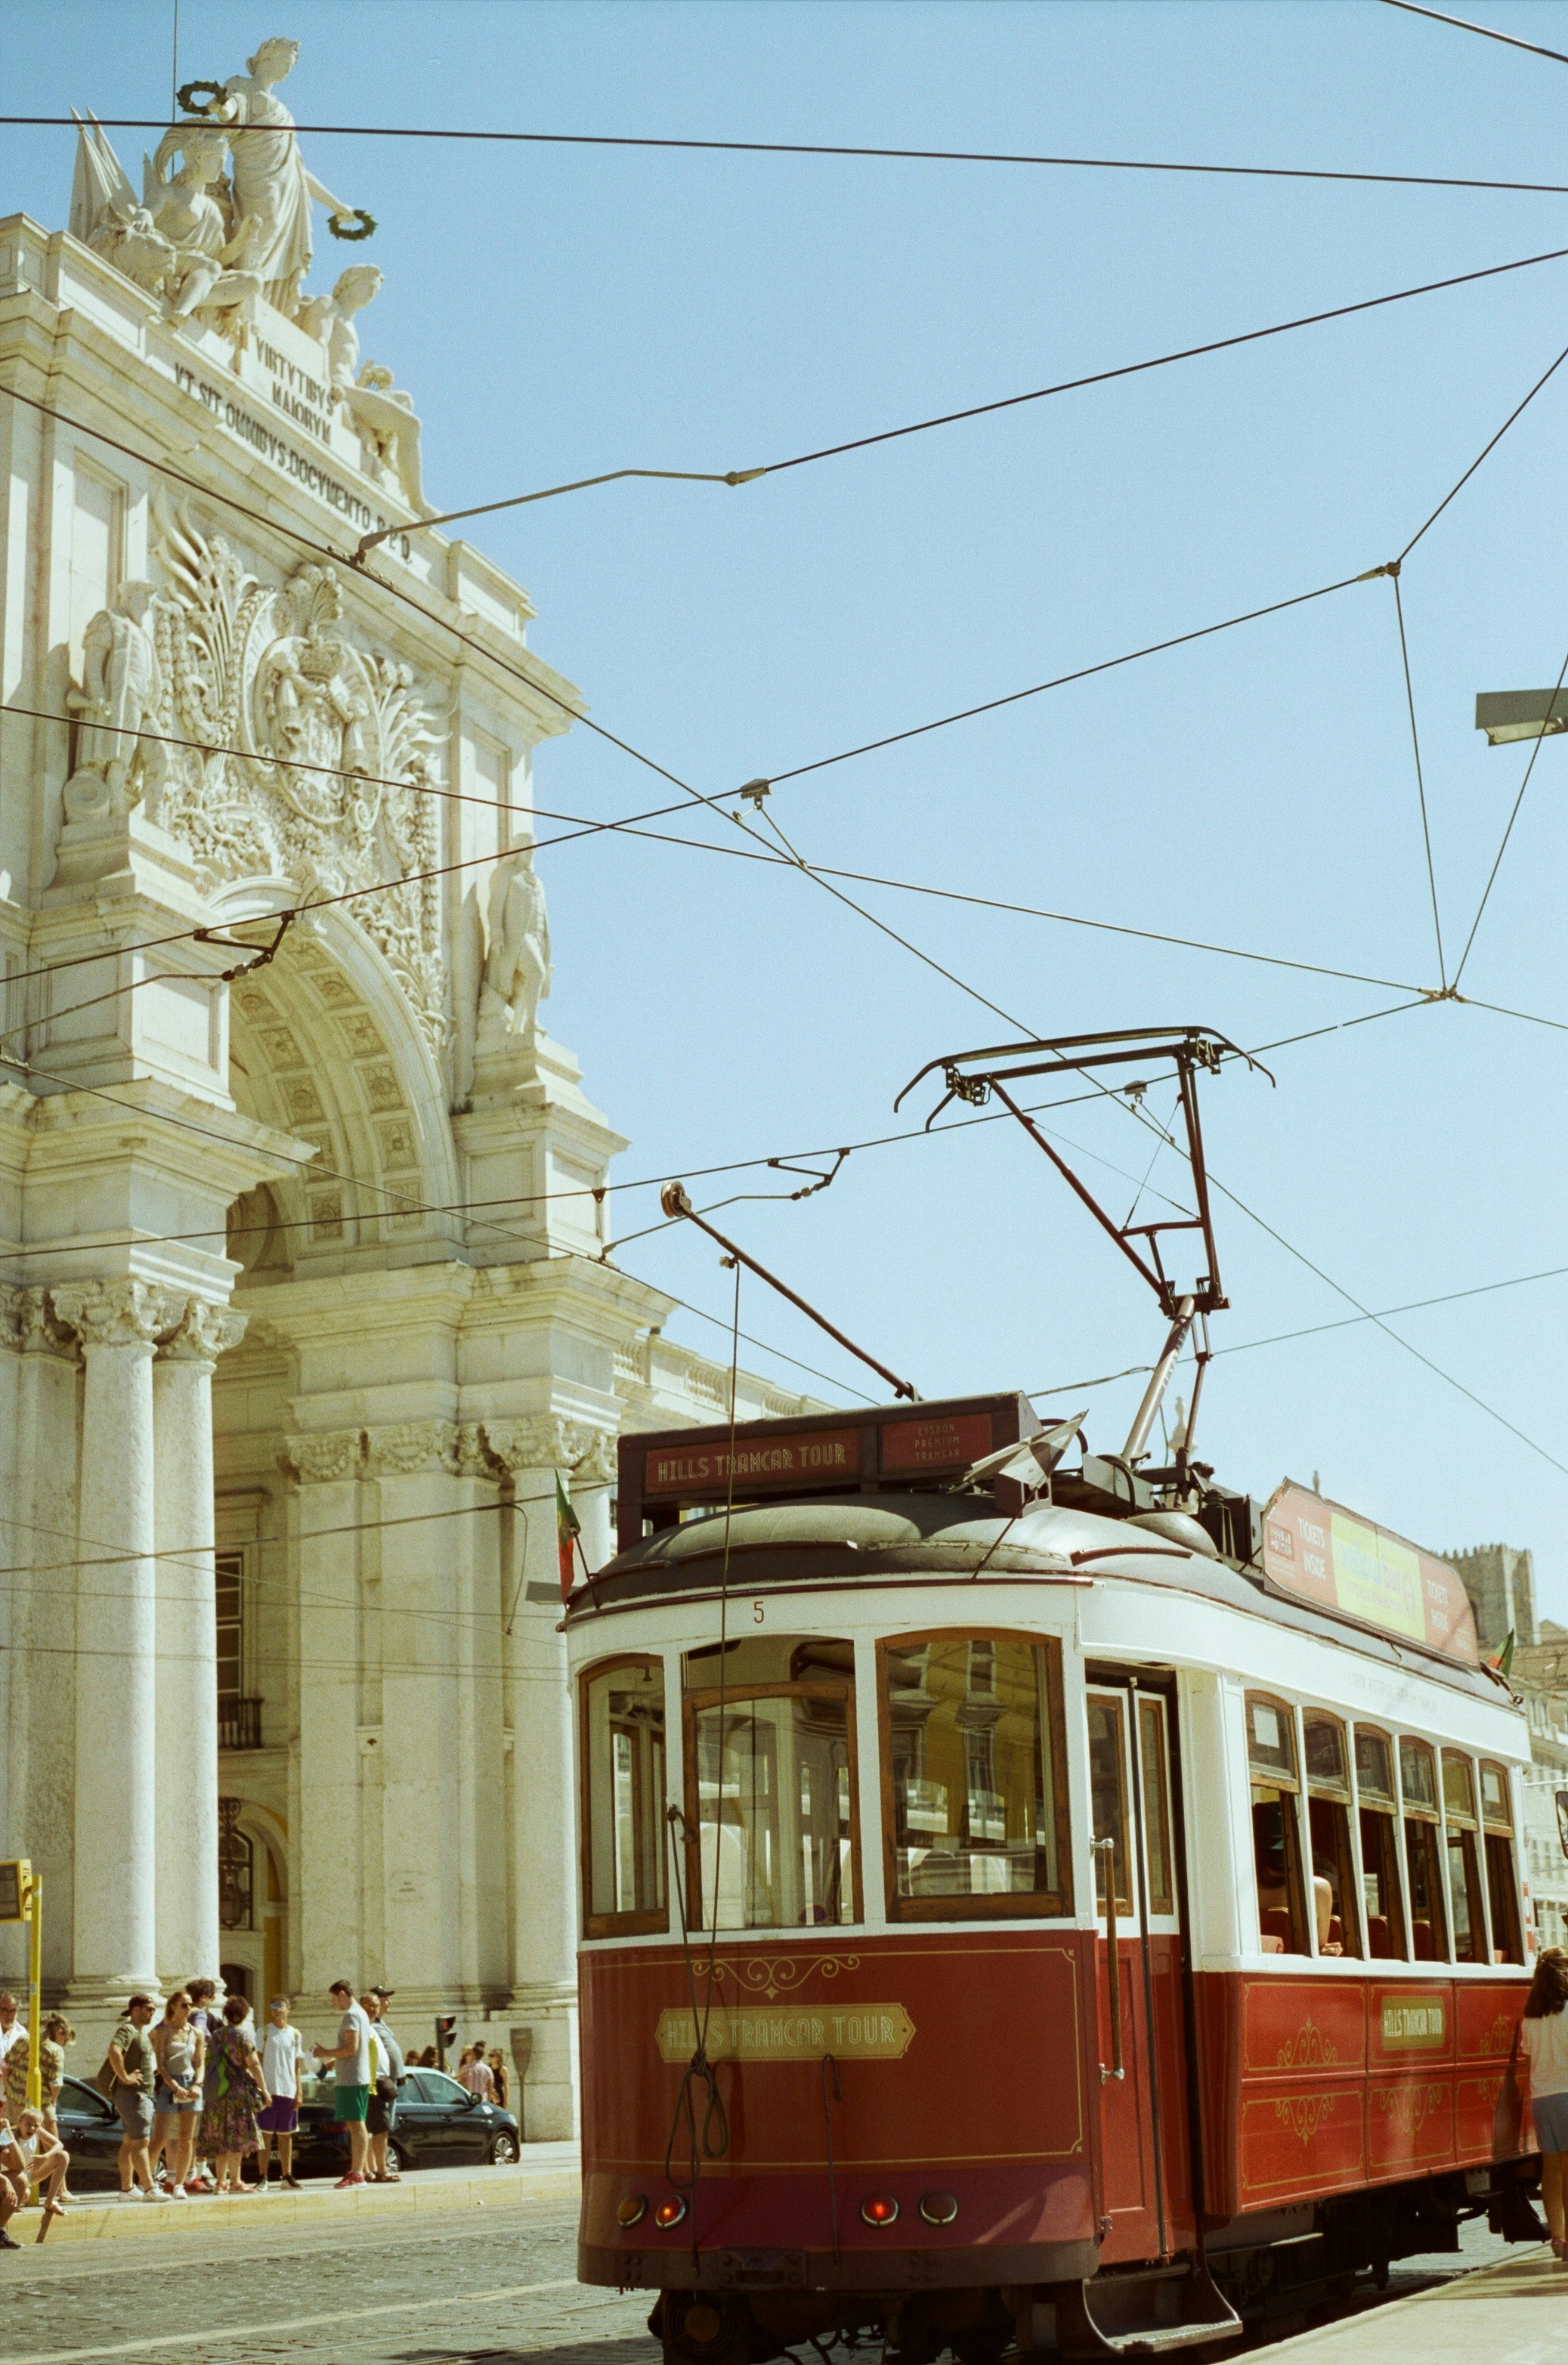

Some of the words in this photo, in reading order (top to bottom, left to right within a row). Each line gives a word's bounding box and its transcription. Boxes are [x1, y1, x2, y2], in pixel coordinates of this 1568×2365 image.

[175, 362, 195, 393] VT
[199, 382, 222, 413] SIT
[273, 381, 331, 446] MAIORVM
[914, 1435, 960, 1449] PREMIUM
[918, 1423, 955, 1436] LISBON
[658, 1457, 710, 1482] HILLS
[714, 1448, 793, 1476] TRAMCAR
[799, 1442, 846, 1468] TOUR
[914, 1448, 960, 1461] TRAMCAR
[1297, 1516, 1325, 1549] TICKETS
[1303, 1550, 1326, 1581] INSIDE
[753, 1600, 765, 1624] 5
[728, 2017, 826, 2048] TRAMCAR
[832, 2015, 896, 2045] TOUR
